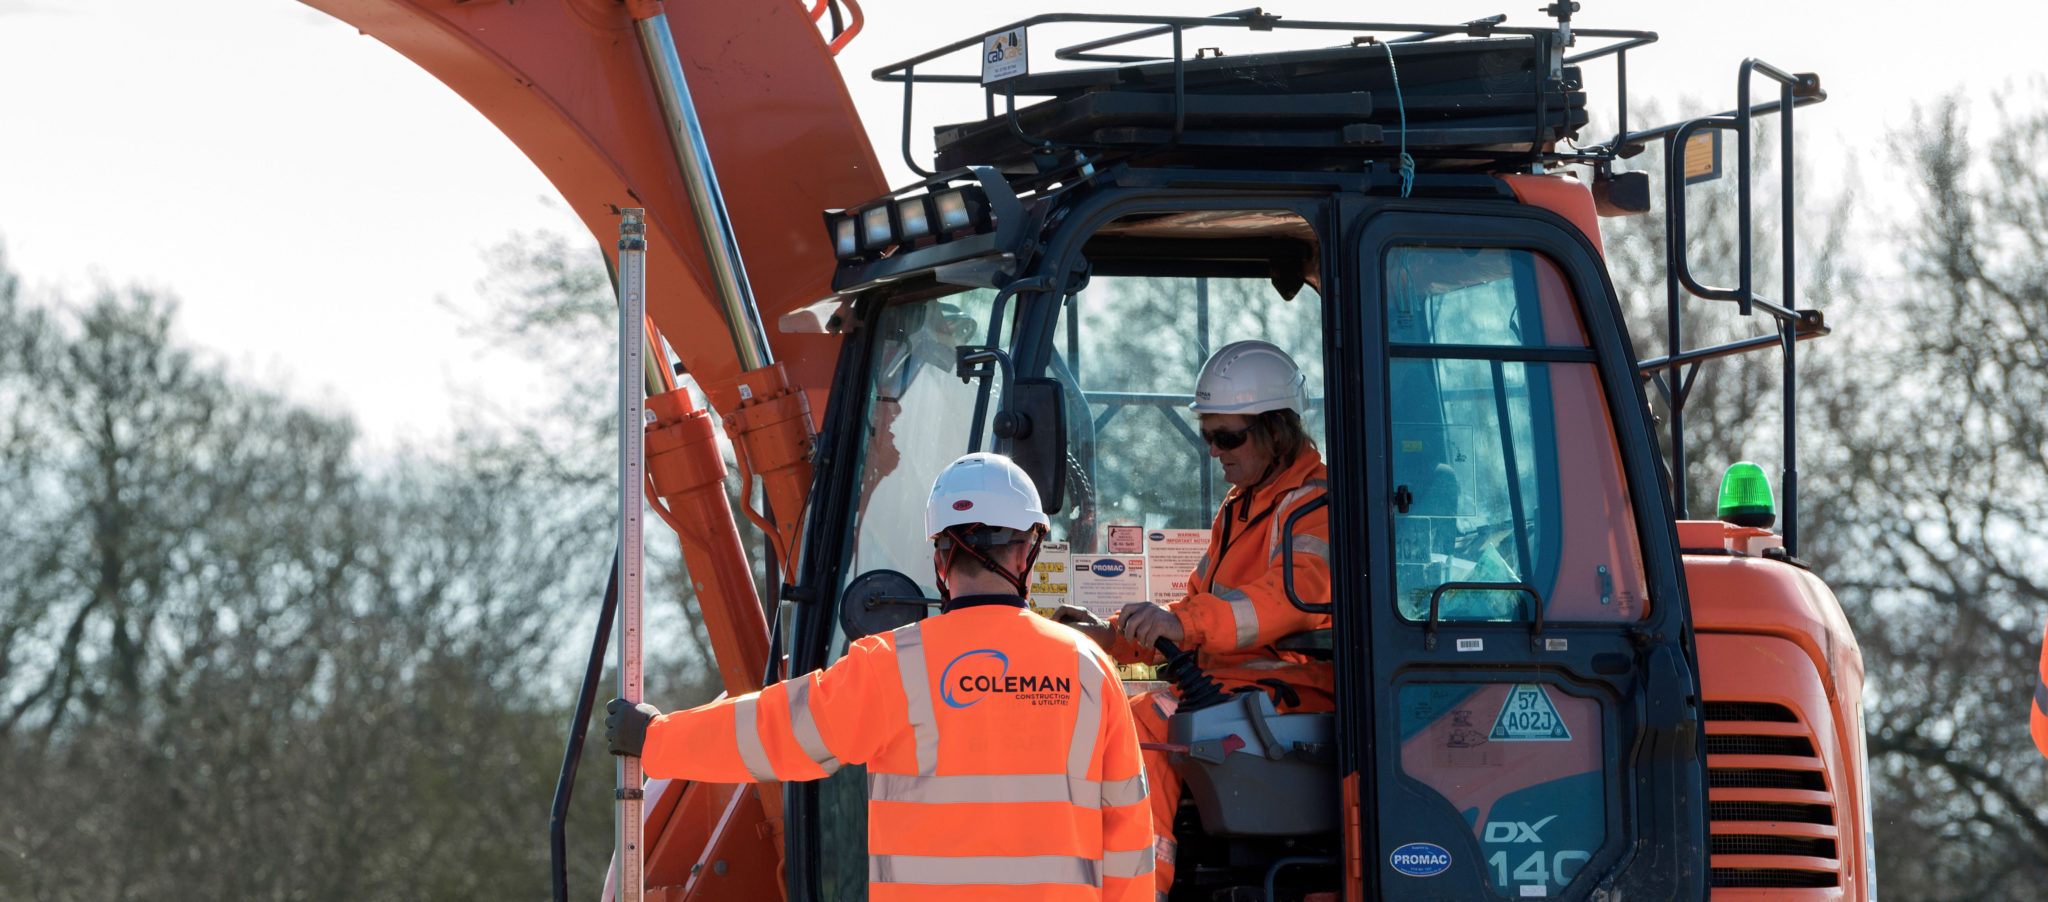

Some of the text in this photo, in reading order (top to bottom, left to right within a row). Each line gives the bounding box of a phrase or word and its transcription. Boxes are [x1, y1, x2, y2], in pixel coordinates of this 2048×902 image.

[959, 675, 1070, 693] COLEMAN
[1518, 691, 1539, 710] 57
[1484, 814, 1559, 843] DX
[1394, 854, 1448, 865] PROMAC
